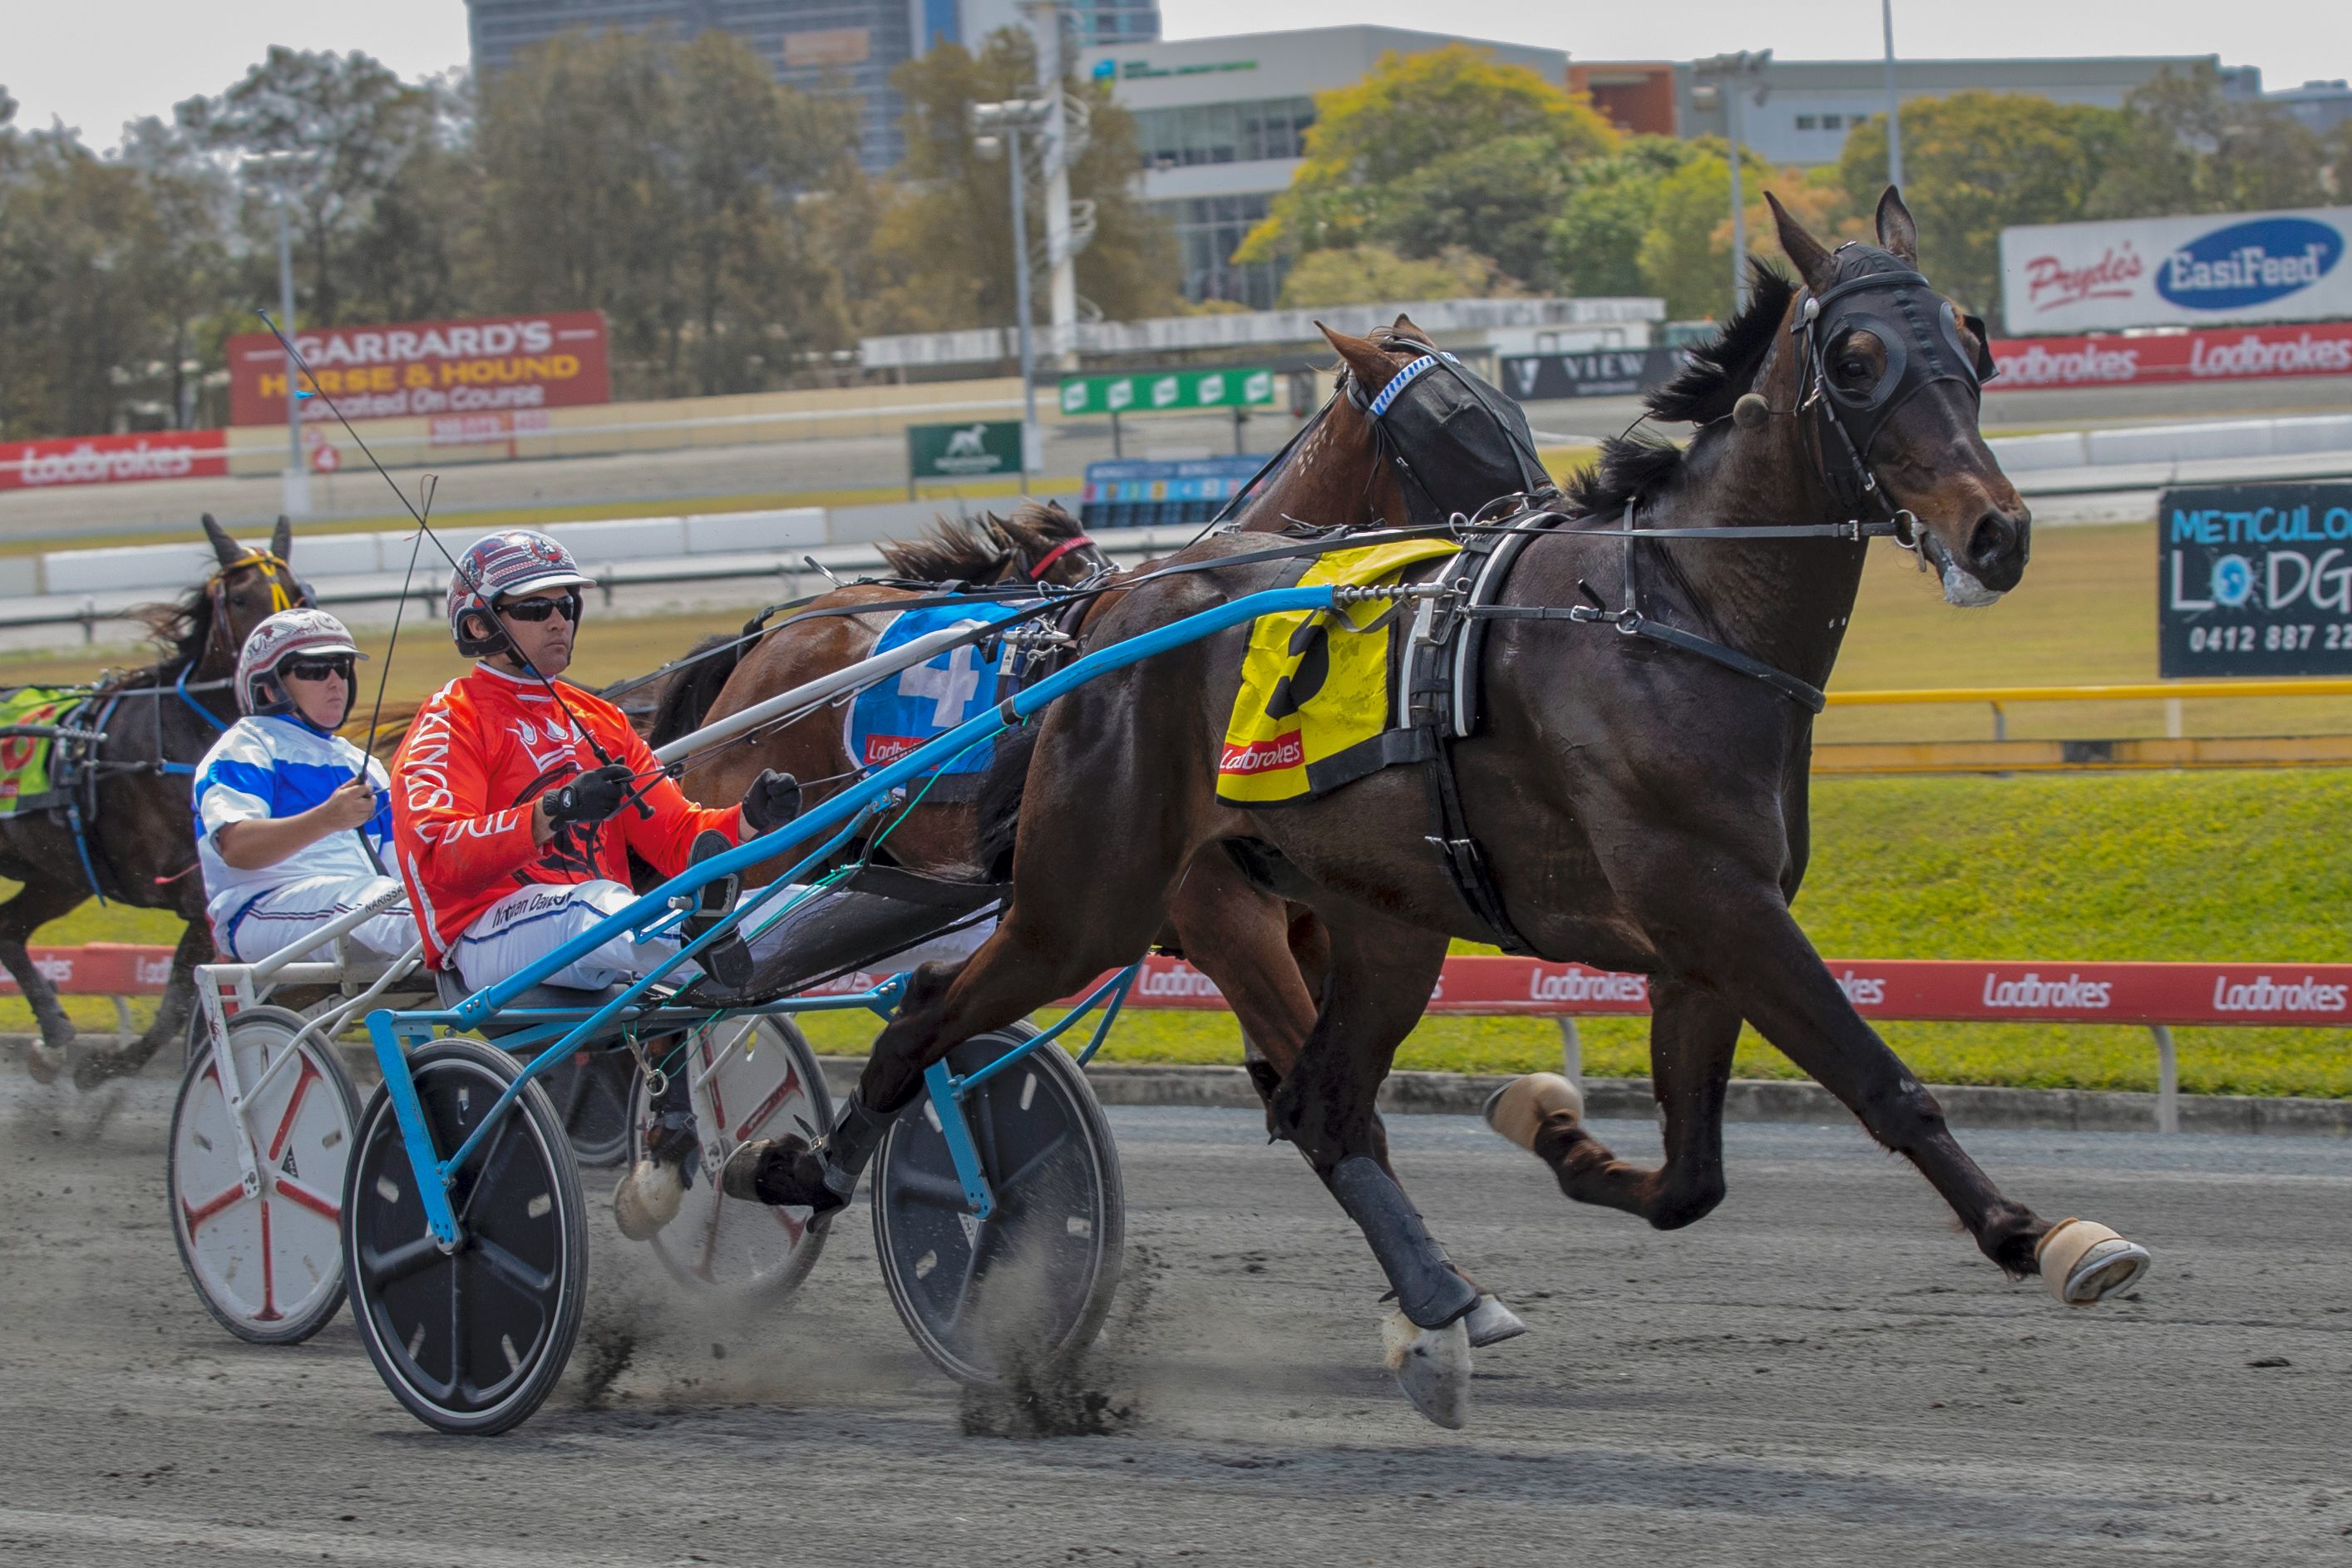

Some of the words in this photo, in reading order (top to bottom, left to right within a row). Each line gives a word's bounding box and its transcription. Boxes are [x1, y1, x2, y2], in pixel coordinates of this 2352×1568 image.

[2026, 241, 2143, 304] Pryde's
[2169, 243, 2321, 291] EasiFeed
[294, 321, 552, 367] GARRARD'S
[2189, 333, 2352, 377] Ladbrokes
[405, 362, 434, 387] &
[441, 355, 579, 386] HOUND
[1563, 352, 1647, 379] VIEW
[1992, 344, 2139, 384] adbrokes
[298, 387, 407, 421] ocated
[412, 387, 452, 413] On
[456, 384, 545, 411] Course
[2170, 505, 2352, 545] METICULO
[2189, 625, 2256, 653] 0412
[2265, 624, 2315, 651] 887
[898, 619, 991, 727] 4
[1138, 964, 1219, 996] Ladbro
[1531, 967, 1647, 1001] Ladbrokes
[1983, 973, 2113, 1008] Ladbrokes
[2213, 975, 2349, 1013] Ladbrokes
